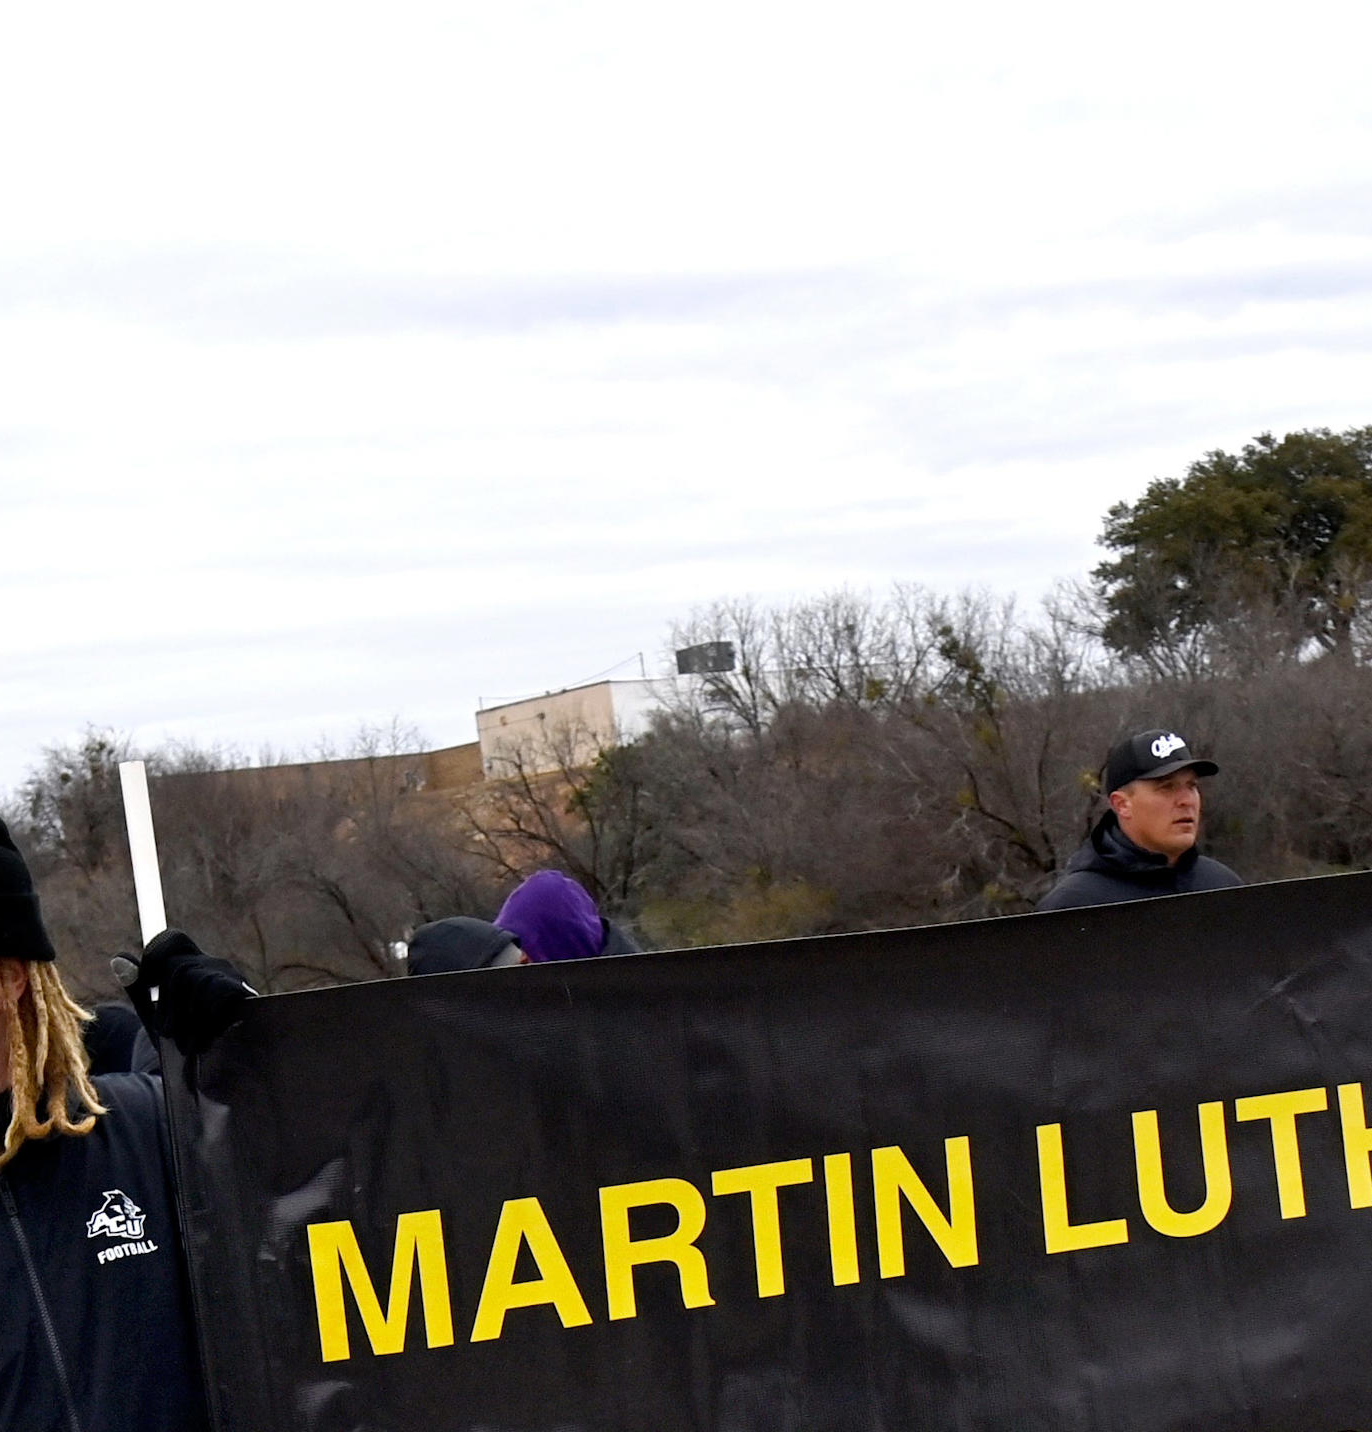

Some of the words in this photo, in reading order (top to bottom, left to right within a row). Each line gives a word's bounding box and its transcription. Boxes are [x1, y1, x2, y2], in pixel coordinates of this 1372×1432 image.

[92, 1212, 141, 1235] ACU
[97, 1240, 158, 1264] FOOTBALL
[307, 1134, 980, 1364] MARTIN
